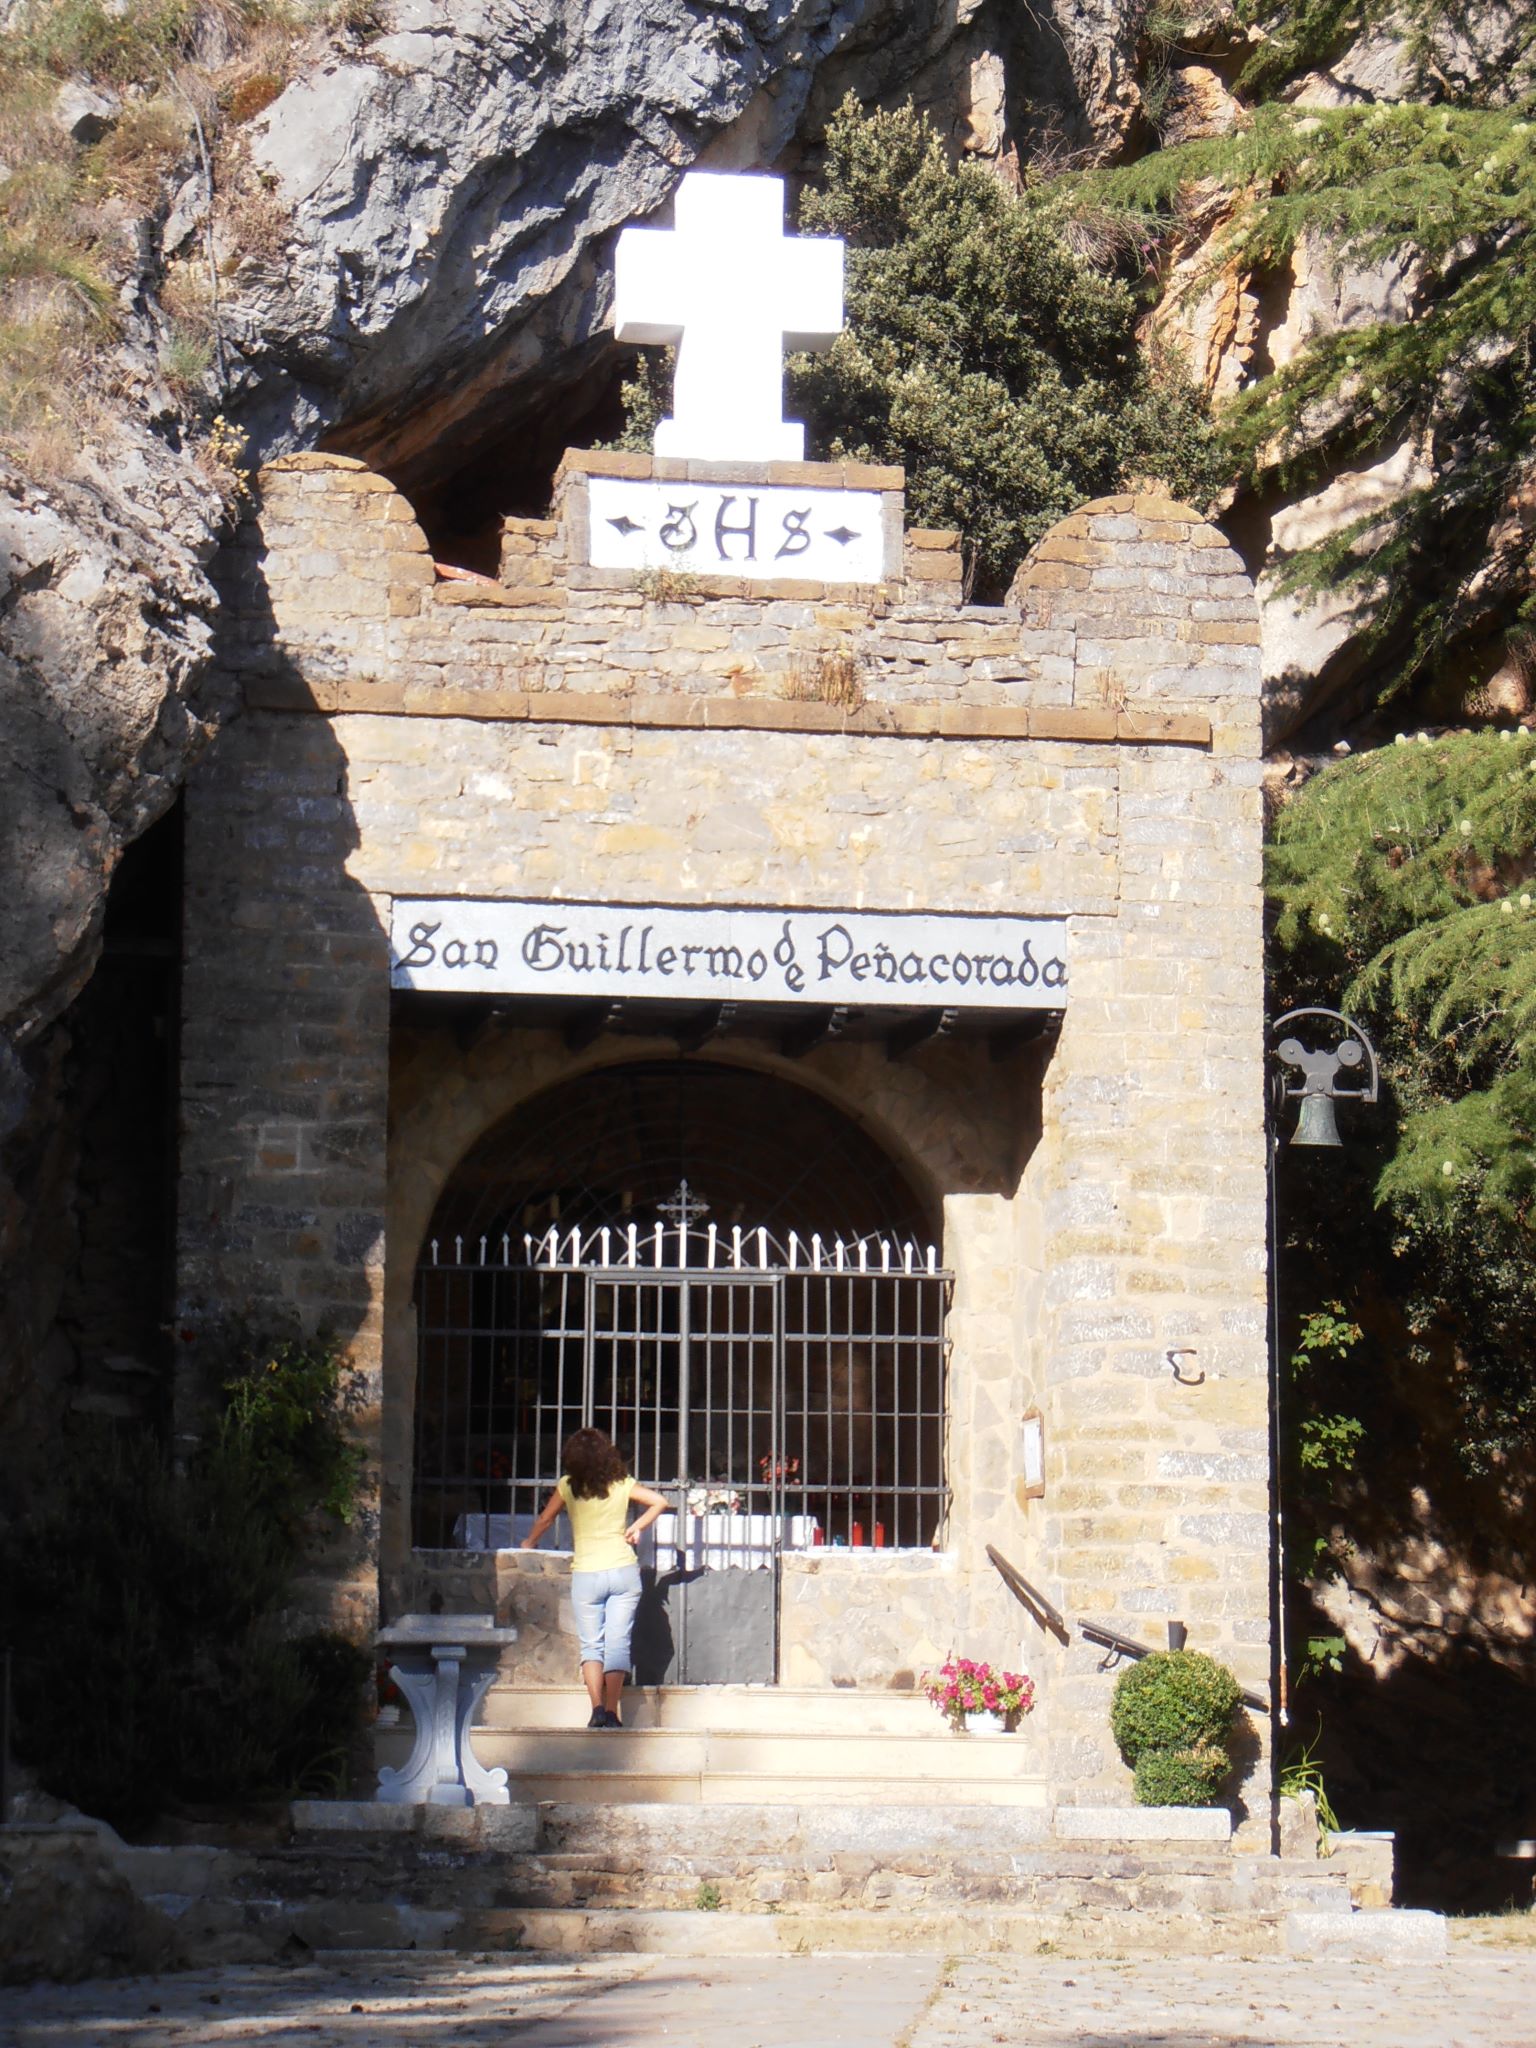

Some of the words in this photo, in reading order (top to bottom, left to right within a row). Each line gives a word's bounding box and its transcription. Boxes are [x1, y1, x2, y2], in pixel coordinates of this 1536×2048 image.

[393, 921, 499, 970] San
[521, 923, 768, 982] Guillermo
[773, 919, 806, 993] de
[816, 923, 1069, 988] Peñacorada
